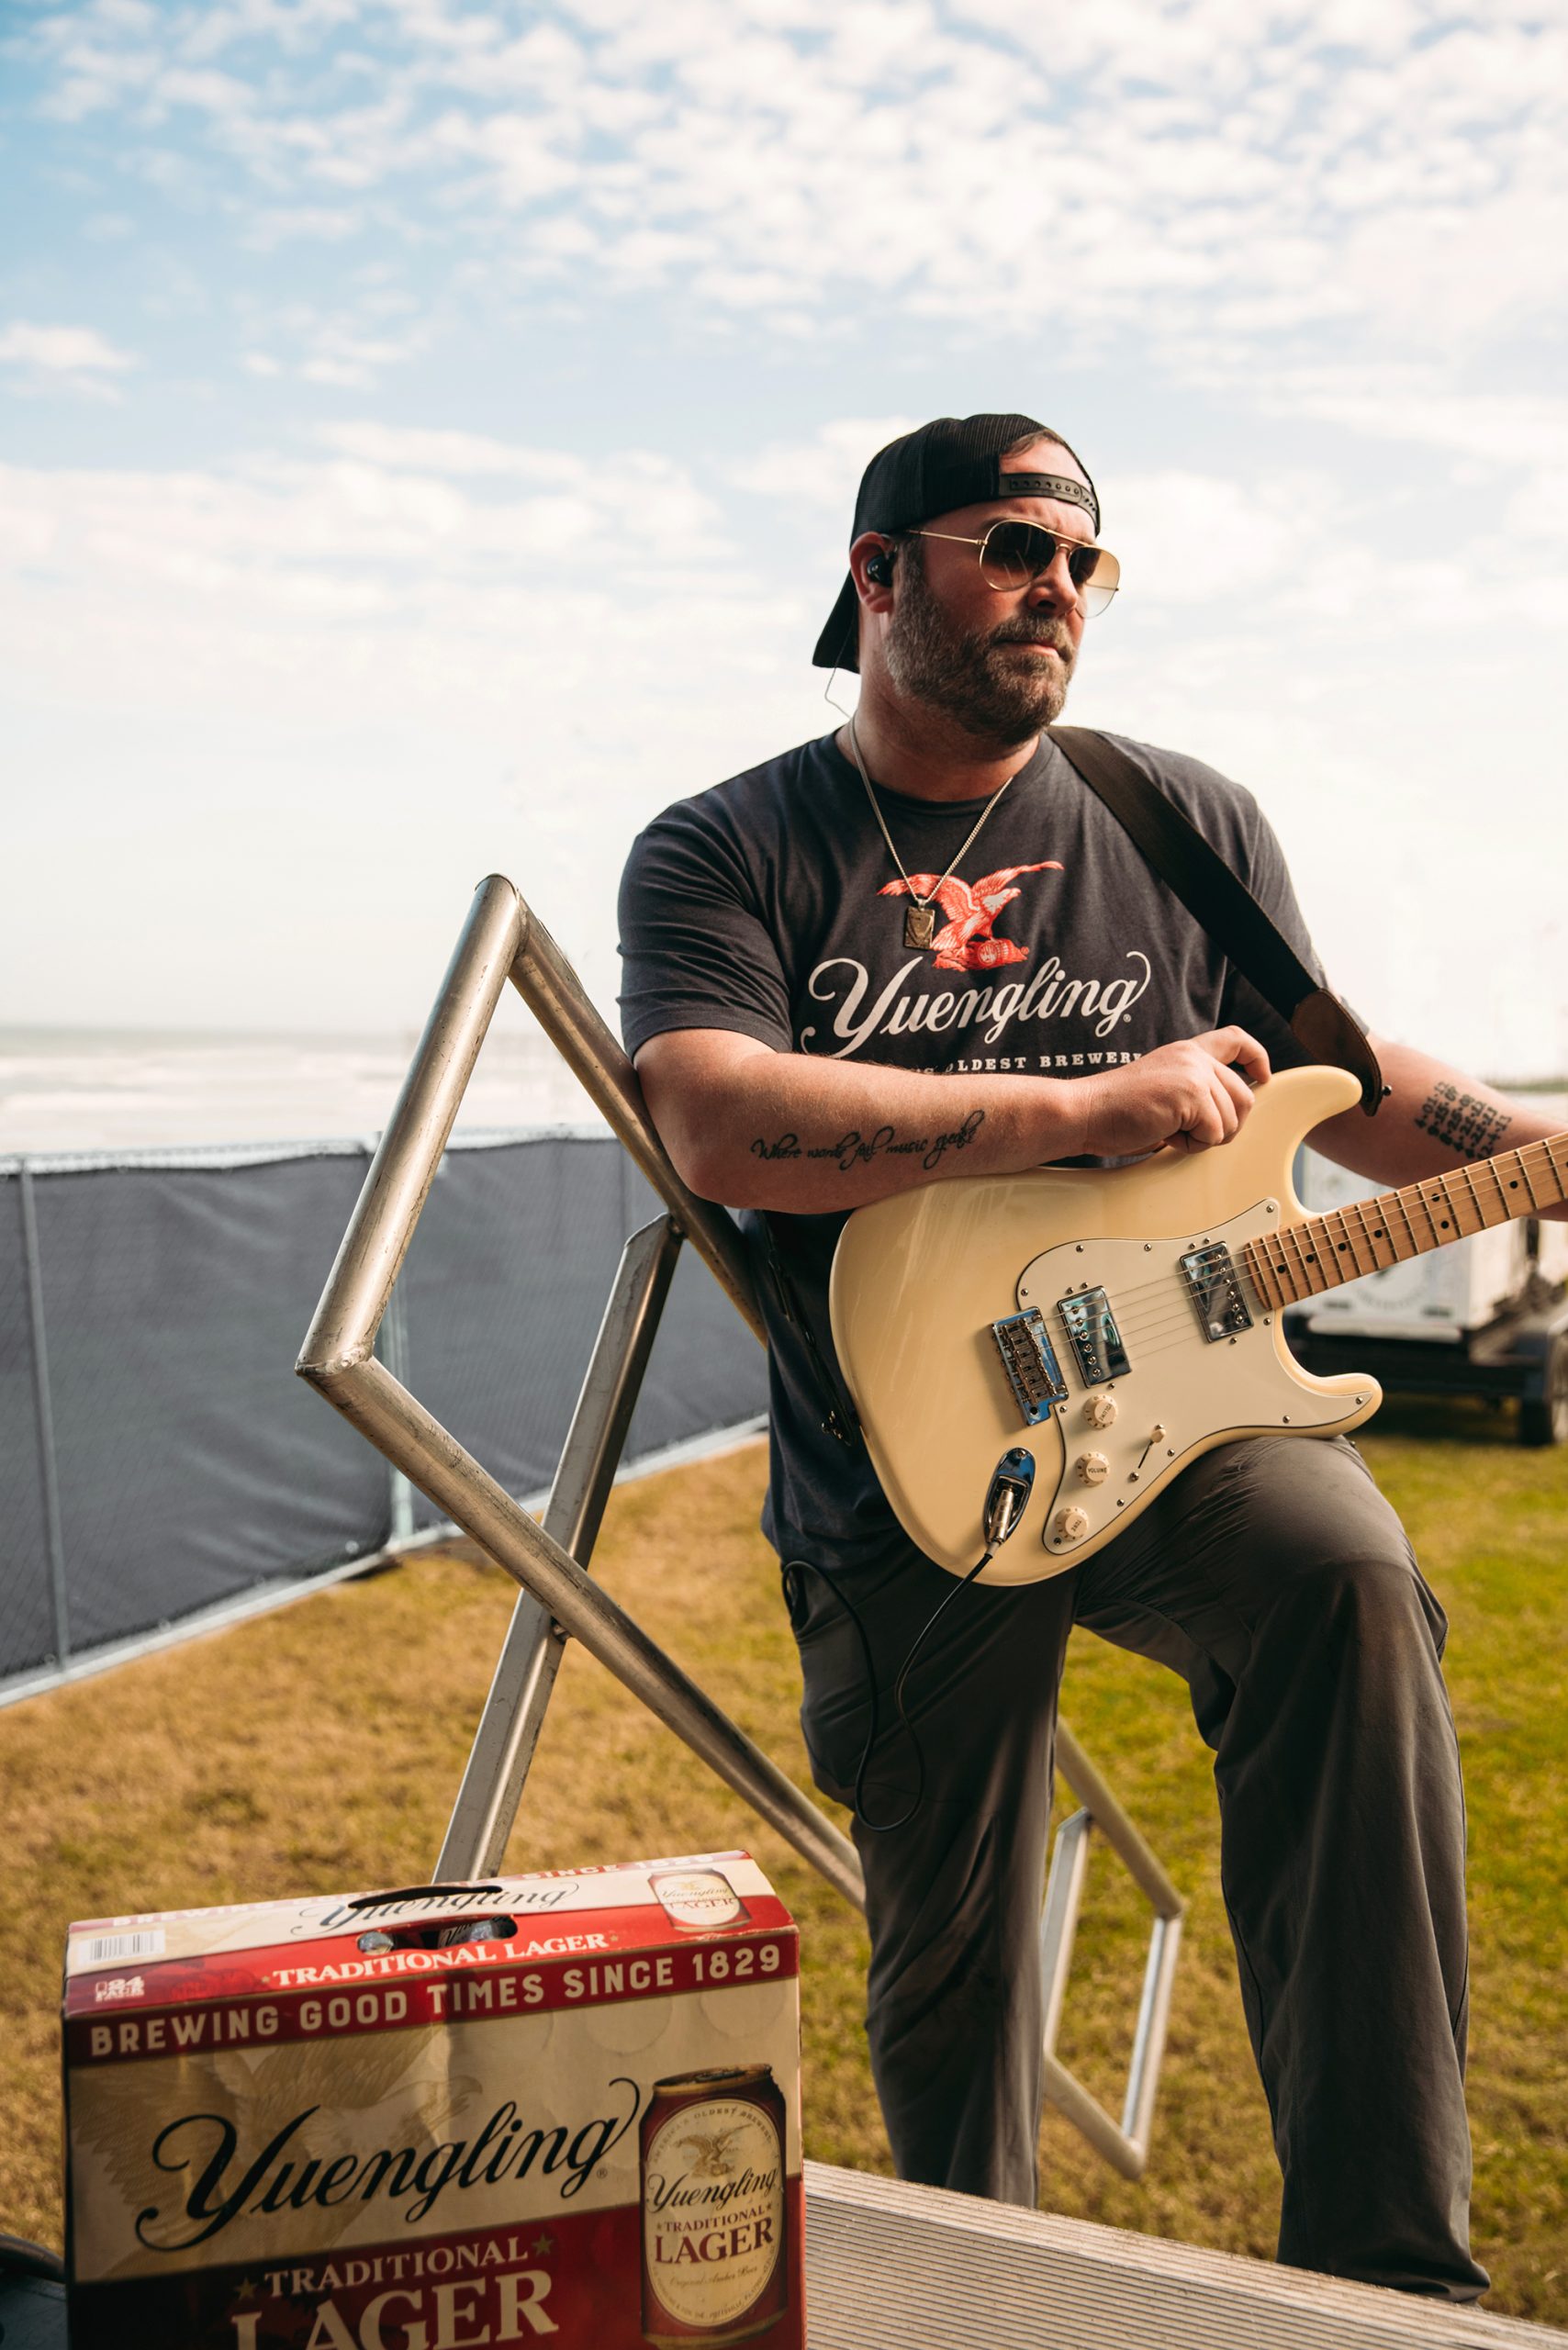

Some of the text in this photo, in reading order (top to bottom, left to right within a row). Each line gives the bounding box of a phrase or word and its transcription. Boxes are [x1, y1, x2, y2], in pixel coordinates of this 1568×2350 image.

[800, 951, 1151, 1059] Yuengling
[273, 1945, 497, 1986] TRADITIONAL
[504, 1932, 610, 1959] LAGER
[91, 1944, 780, 2056] BREWING GOOD TIMES SINCE 1829
[135, 2077, 640, 2252] Yuengling
[646, 2167, 779, 2213] Yuengling
[655, 2217, 775, 2265] LAGER
[664, 2205, 766, 2232] TRADITIONAL
[264, 2237, 529, 2298] TRADITIONAL
